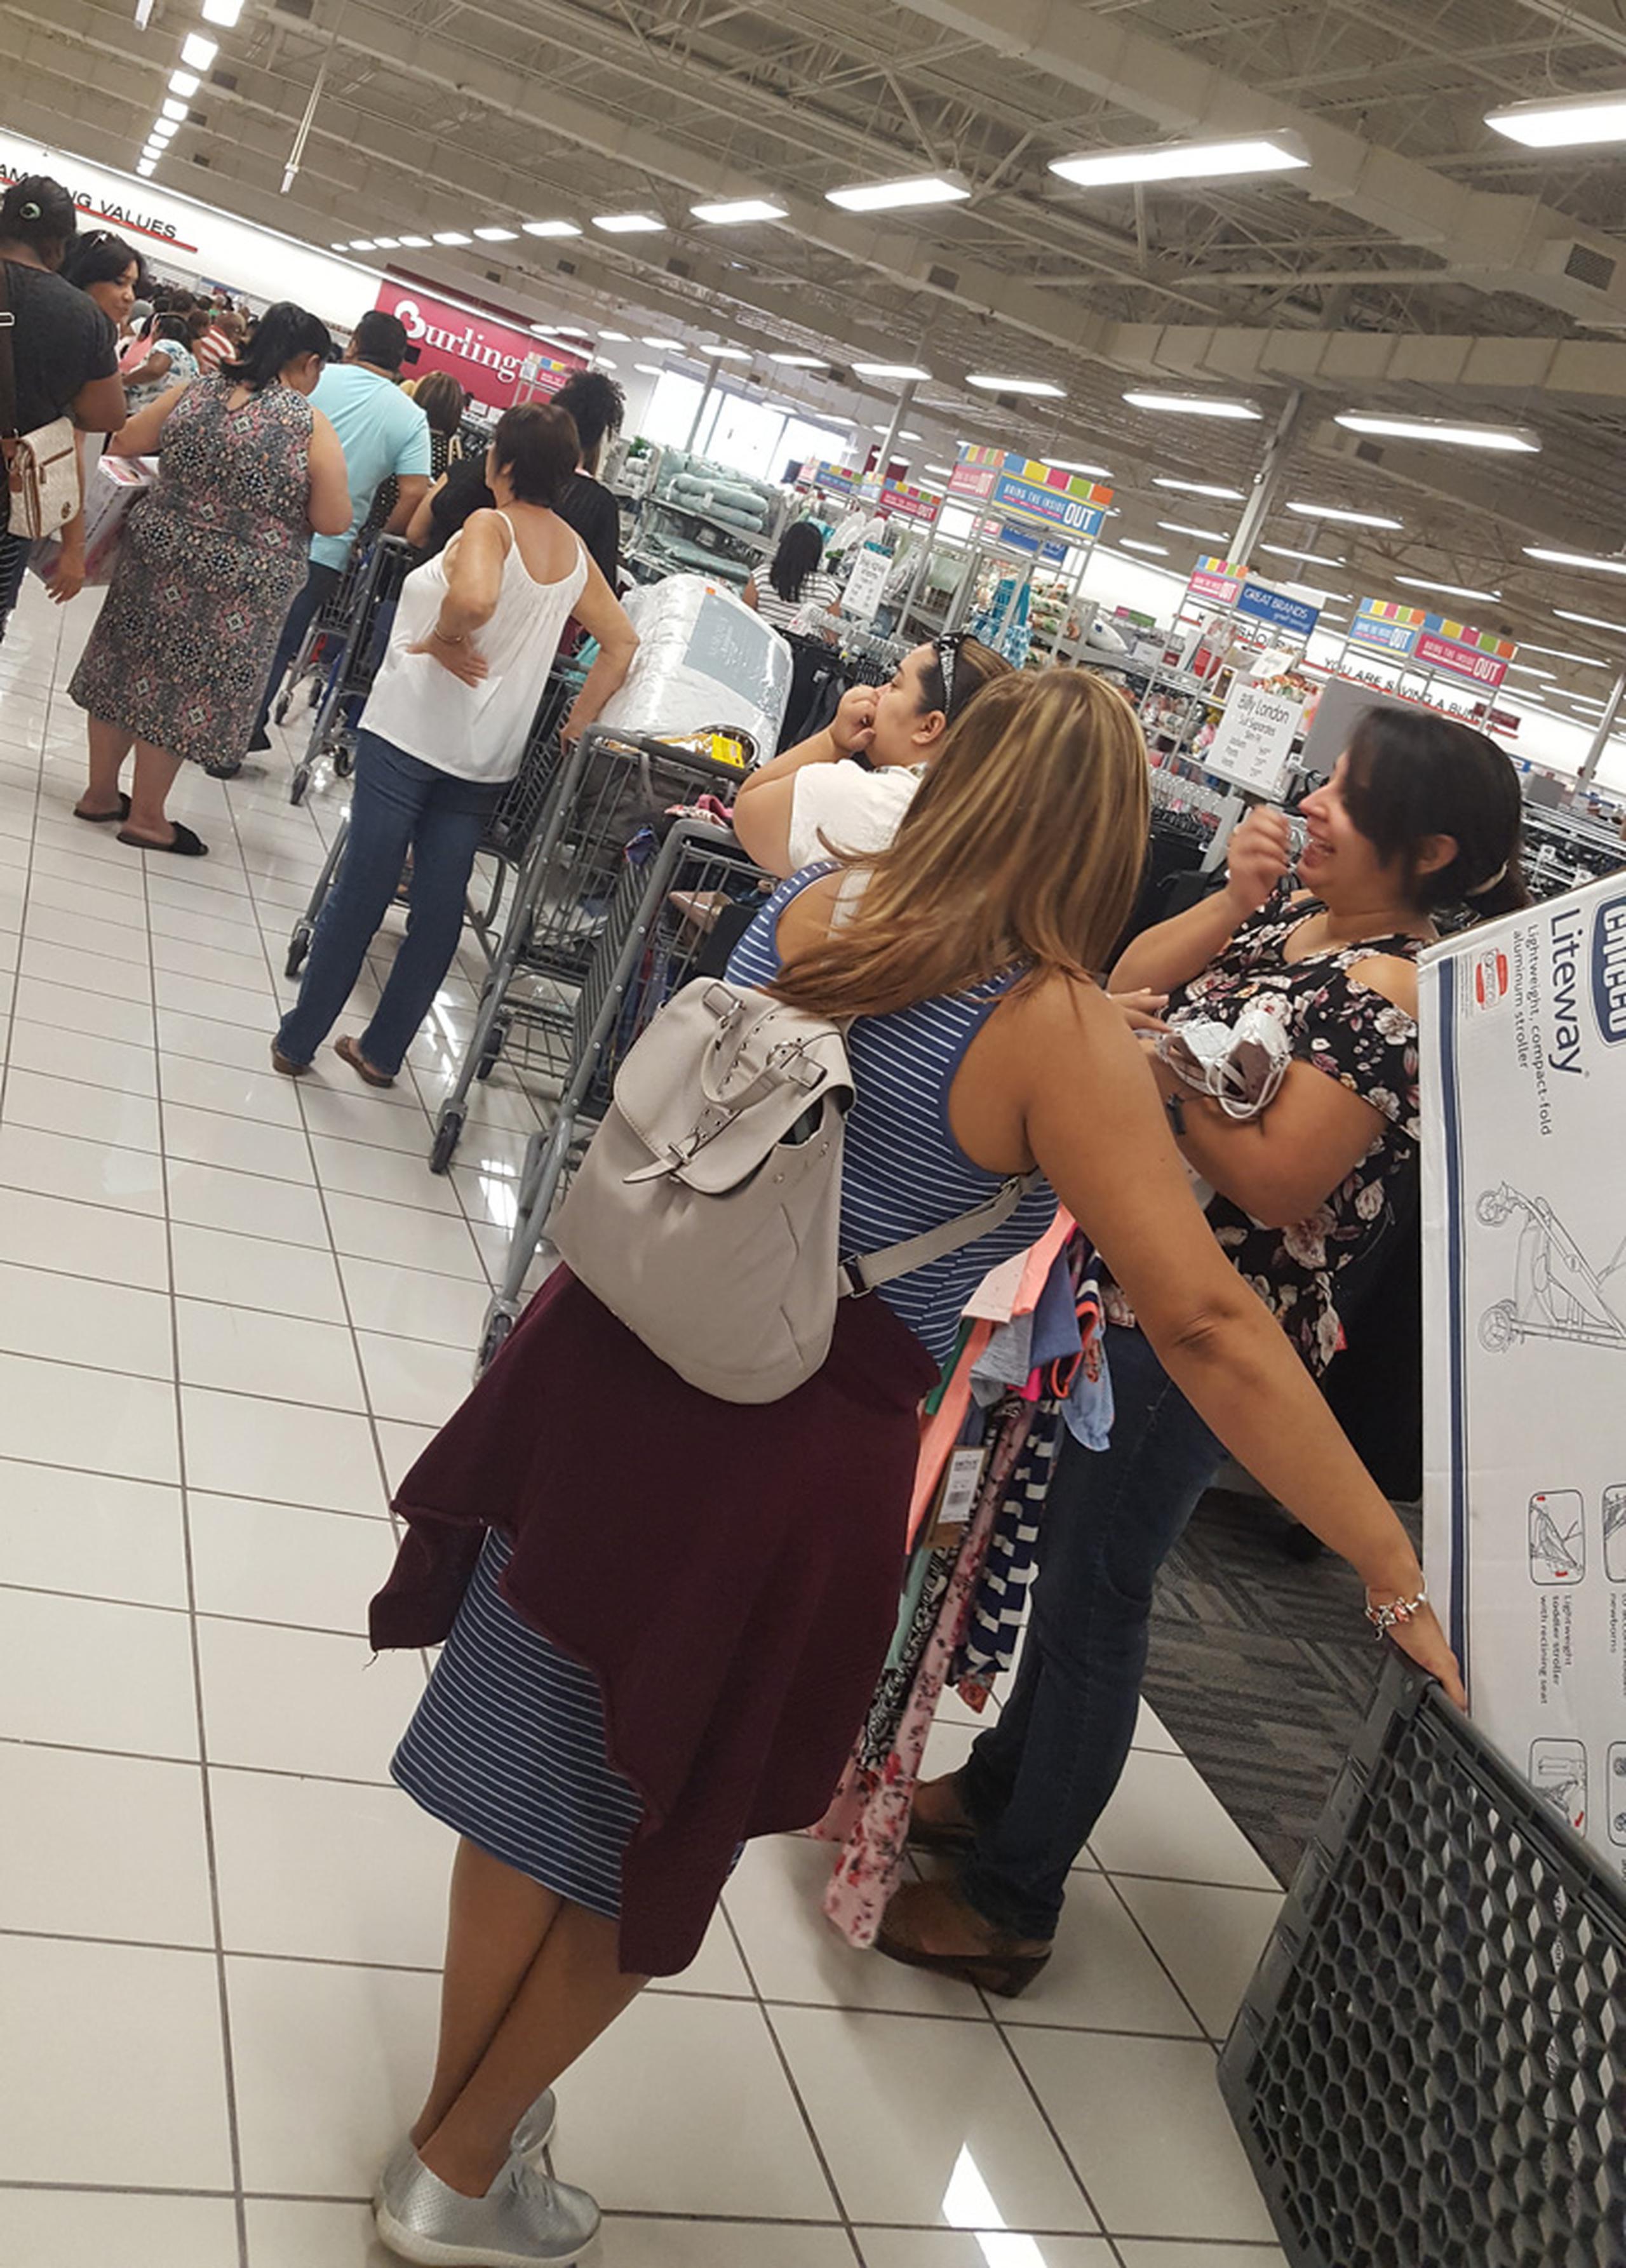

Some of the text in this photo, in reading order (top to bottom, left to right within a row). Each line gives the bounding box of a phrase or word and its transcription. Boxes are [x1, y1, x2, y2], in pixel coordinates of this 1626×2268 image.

[100, 199, 177, 239] VALUES
[1004, 484, 1026, 499] BRING
[1063, 502, 1096, 530] OUT
[1243, 587, 1308, 619] GREAT BRANDS
[1354, 670, 1383, 684] ARE
[1474, 657, 1501, 682] OUT
[1255, 699, 1289, 725] London
[1513, 930, 1529, 1069] aluminum stroller
[1548, 908, 1583, 1074] Liteway
[1525, 923, 1553, 1136] Lightweight, compact-fold
[1552, 1595, 1562, 1686] toddler stroller
[1562, 1595, 1572, 1665] Lightweight
[1609, 1592, 1618, 1654] newborns
[1539, 1625, 1548, 1677] reclining
